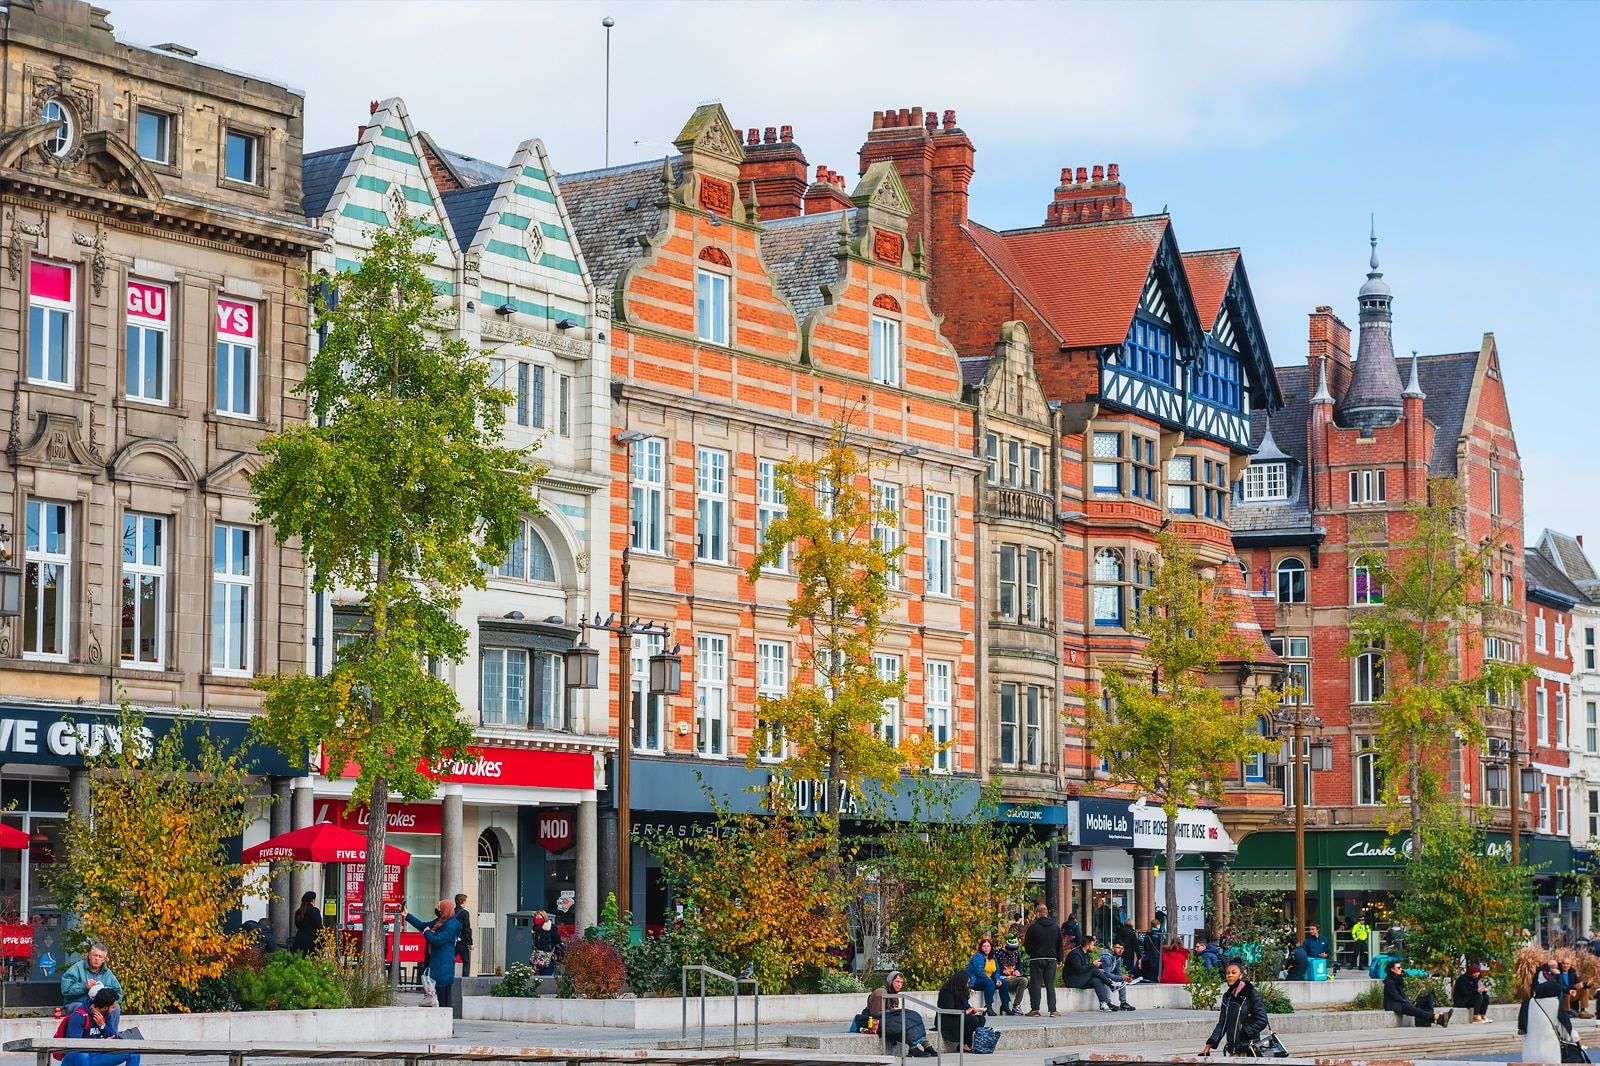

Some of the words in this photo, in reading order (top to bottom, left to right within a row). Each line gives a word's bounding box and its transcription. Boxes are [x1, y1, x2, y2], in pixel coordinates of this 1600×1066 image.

[540, 819, 569, 839] MOD
[1086, 813, 1112, 831] Mobile
[1113, 815, 1128, 832] Lab
[1134, 819, 1152, 836] WHITE
[1152, 820, 1168, 836] ROSE
[1191, 823, 1206, 839] ROSE
[259, 849, 274, 858] FIVE
[274, 847, 293, 857] GUYS
[336, 850, 357, 859] FIVE
[1346, 841, 1397, 857] Clarks
[404, 944, 419, 952] GUYS
